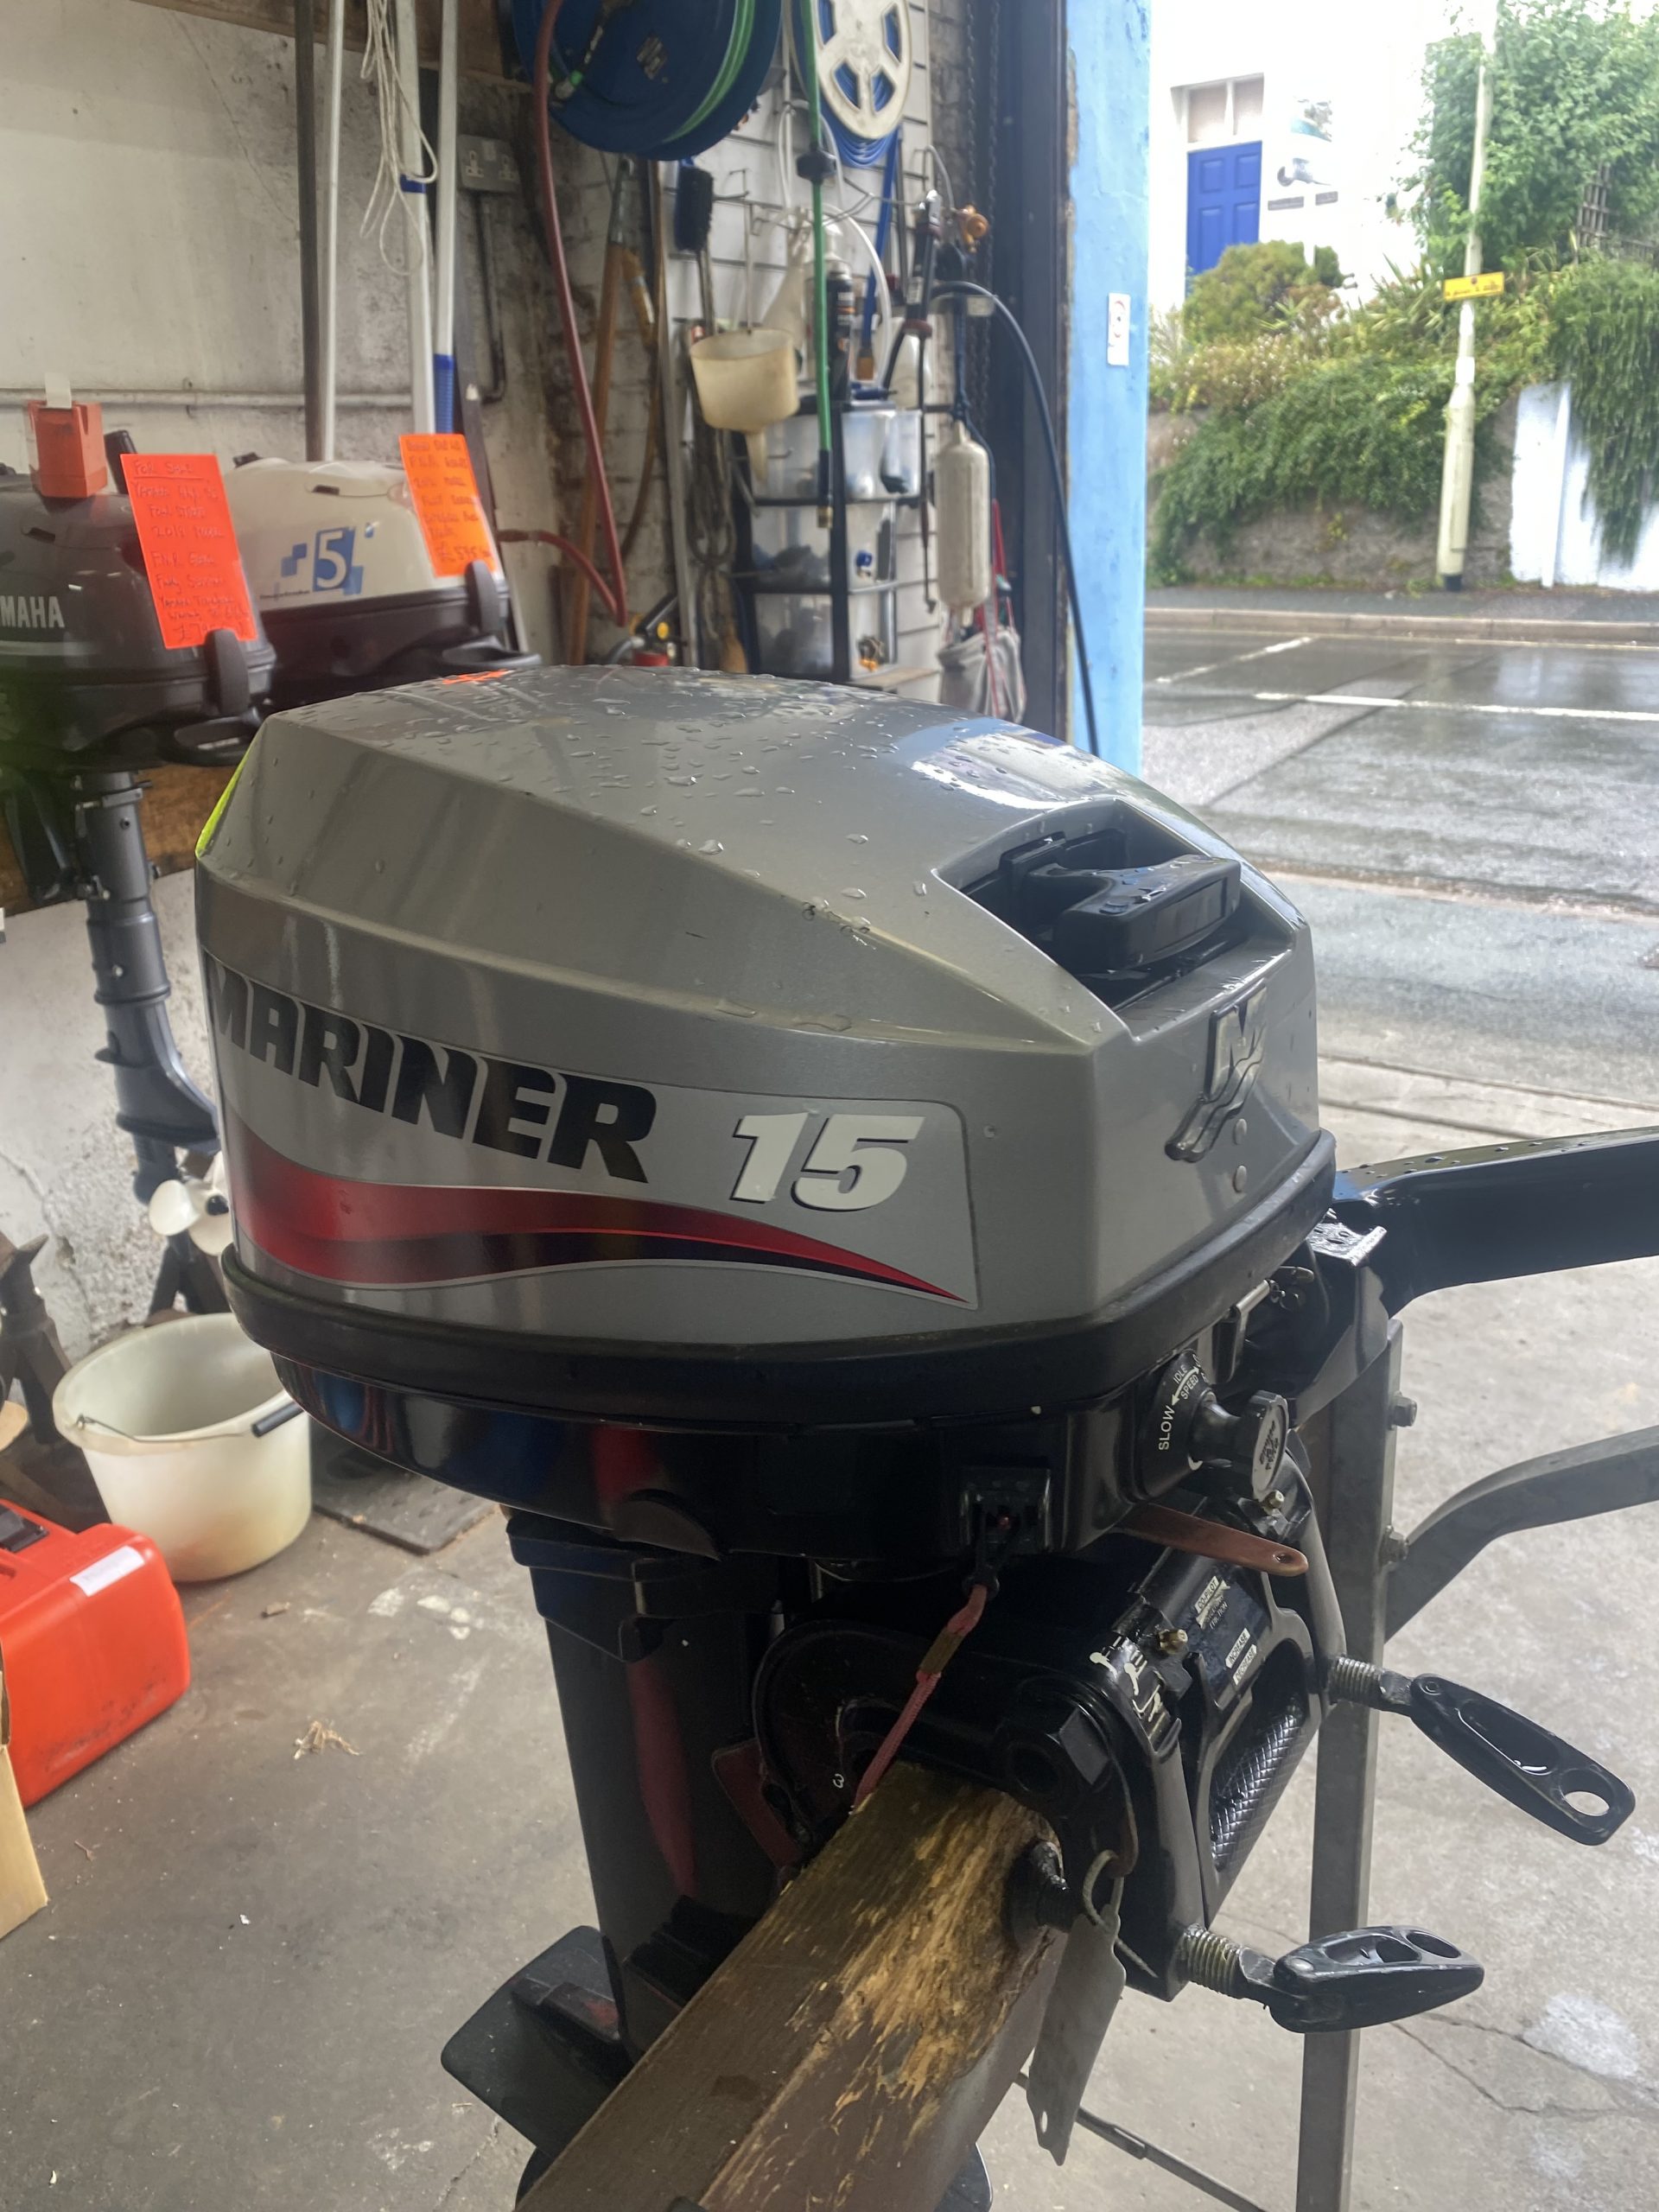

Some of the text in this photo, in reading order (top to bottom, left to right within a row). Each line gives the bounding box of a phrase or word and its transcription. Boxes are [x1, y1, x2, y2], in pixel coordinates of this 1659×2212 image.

[316, 530, 346, 588] 5
[206, 953, 926, 1212] MARINER 15
[1173, 1364, 1188, 1384] IDLE
[1180, 1374, 1199, 1400] SPEED
[1159, 1405, 1176, 1451] SLOW
[1198, 1580, 1217, 1609] CO-PILOT
[1228, 1632, 1248, 1665] INCREASE
[1235, 1647, 1255, 1681] DECREASE
